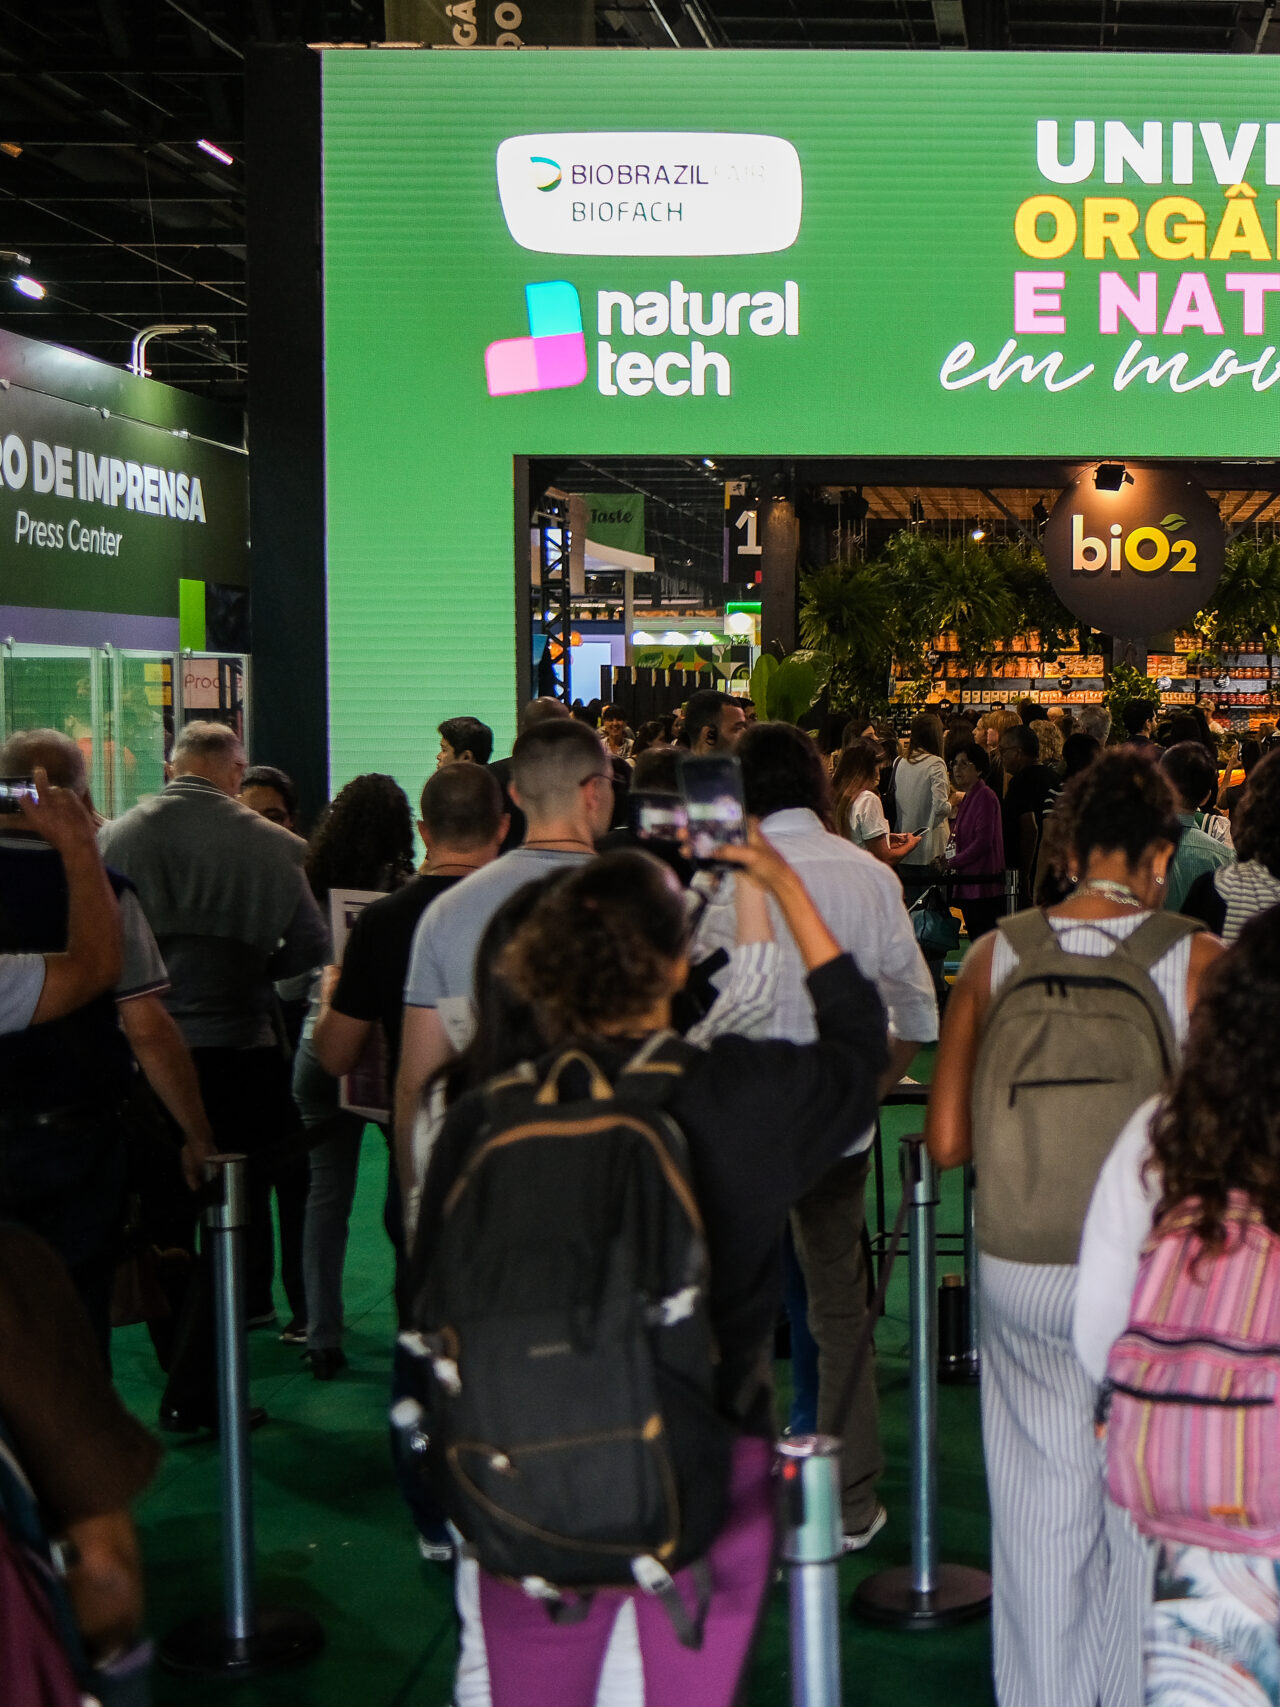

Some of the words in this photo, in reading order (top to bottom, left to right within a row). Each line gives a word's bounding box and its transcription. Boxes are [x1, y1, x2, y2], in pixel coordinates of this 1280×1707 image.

[571, 164, 709, 185] BIOBRAZIL
[571, 202, 684, 222] BIOFACH
[597, 280, 799, 337] natural
[1013, 270, 1067, 334] E
[597, 340, 732, 397] tech
[939, 338, 1095, 392] em
[32, 440, 75, 499] DE
[77, 450, 208, 524] IMPRENSA
[15, 510, 64, 549] Press
[68, 518, 123, 557] Center
[590, 509, 633, 524] Taste
[735, 510, 762, 555] 1
